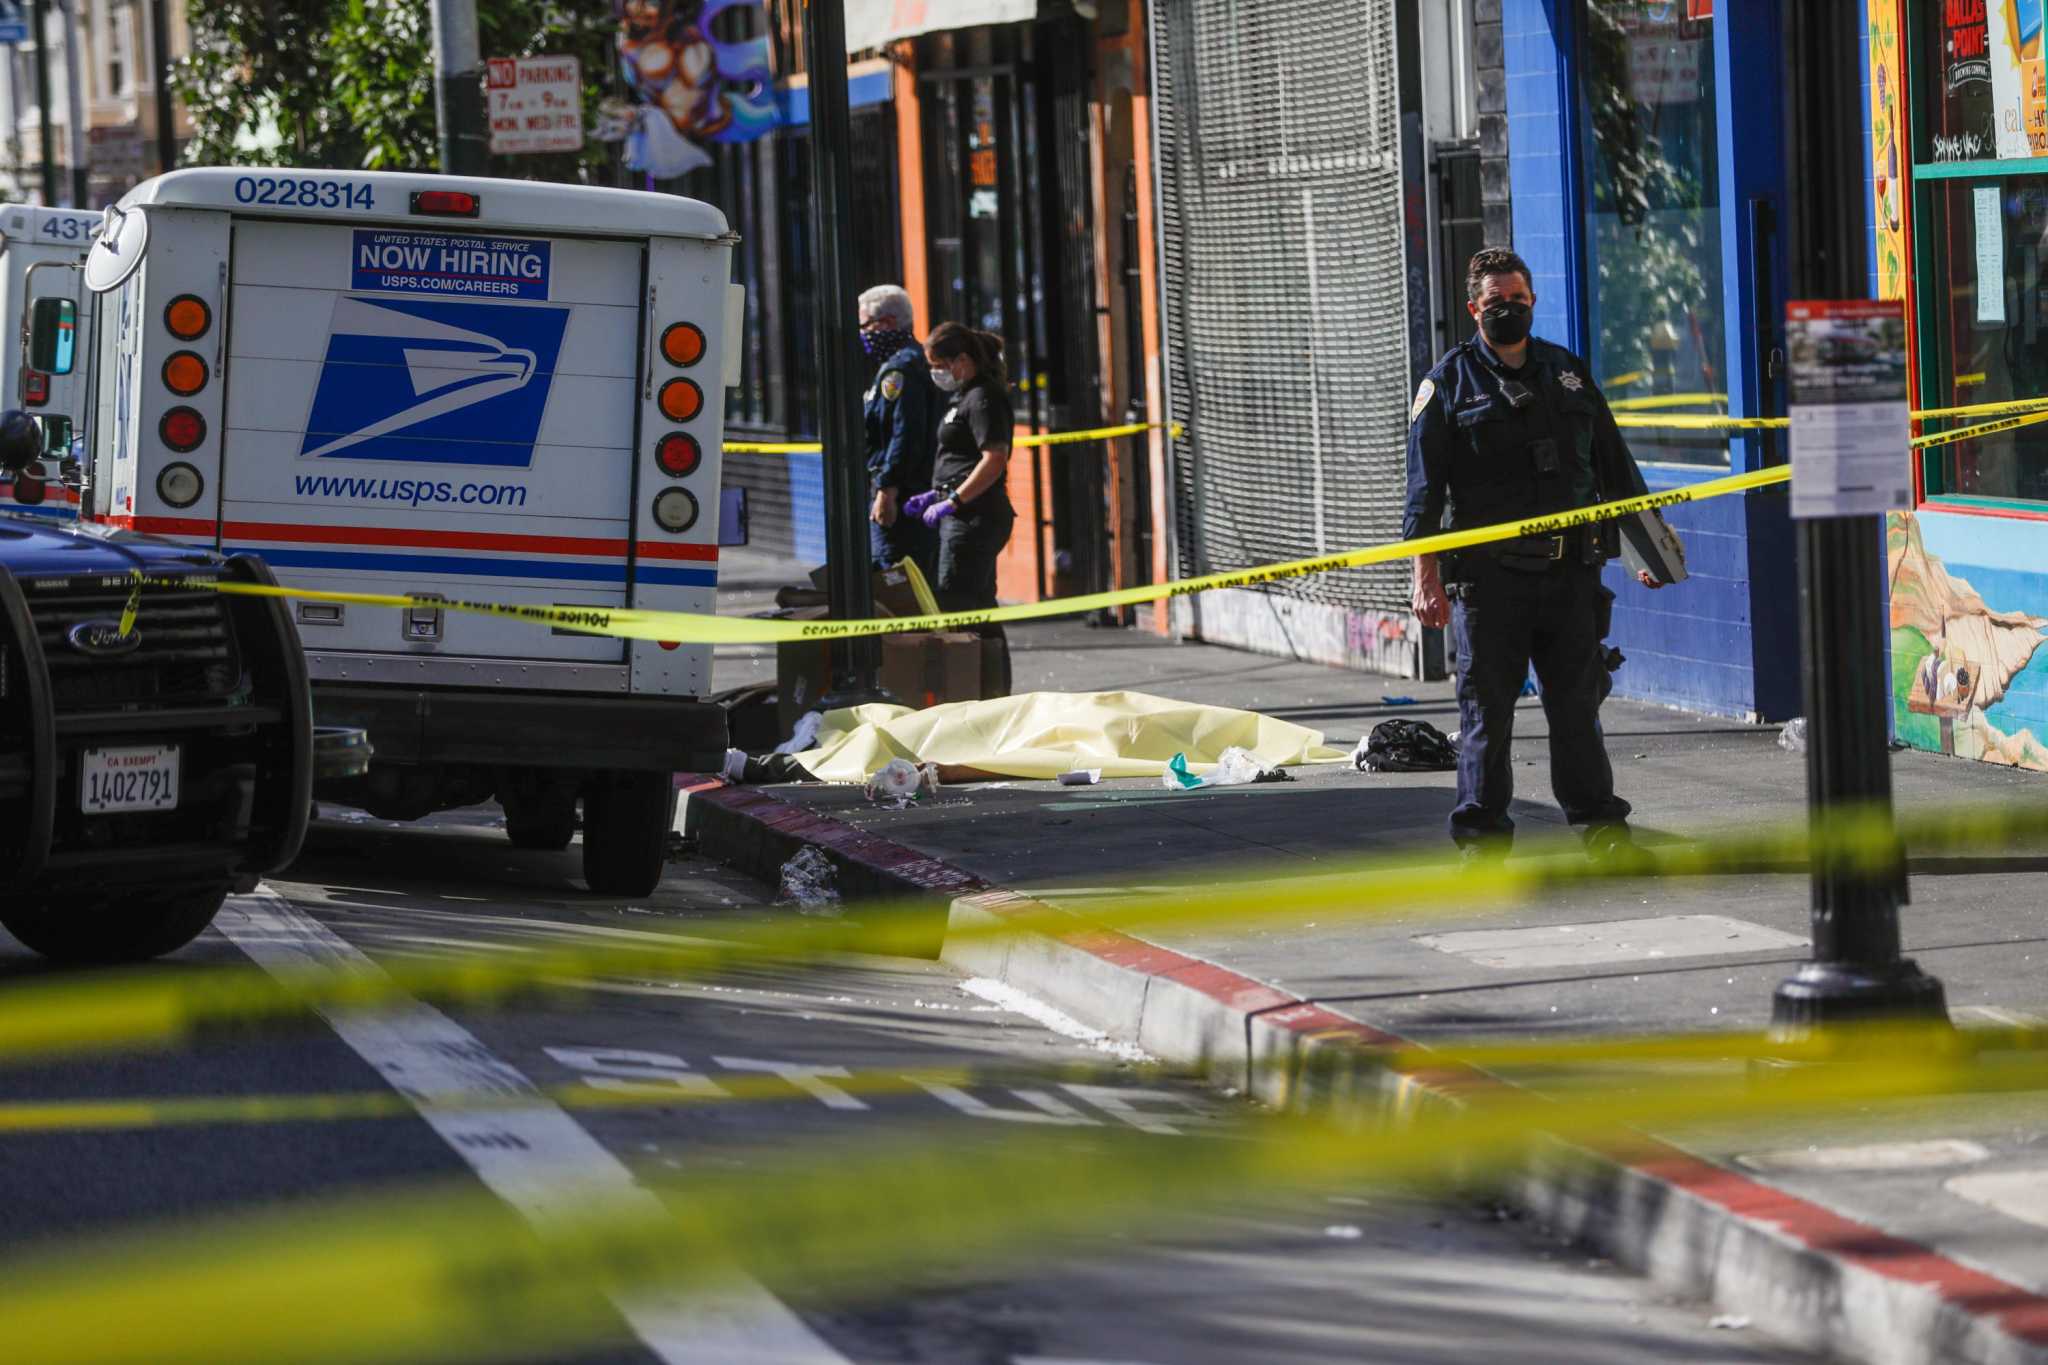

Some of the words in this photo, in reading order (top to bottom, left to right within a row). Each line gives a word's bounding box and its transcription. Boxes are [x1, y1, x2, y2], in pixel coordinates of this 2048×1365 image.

[1946, 0, 1985, 28] BALLAS
[1952, 25, 1985, 59] POINT
[234, 176, 376, 210] 0228314
[42, 216, 103, 241] 431
[374, 234, 410, 245] UNITED
[413, 236, 448, 247] STATES
[450, 238, 487, 249] POSTAL
[491, 241, 530, 252] SERVICE
[360, 244, 432, 271] NOW
[440, 248, 542, 279] HIRING
[381, 275, 519, 295] USPS.COM/CAREERS
[295, 474, 527, 507] www.usps.com
[559, 612, 610, 628] POLICE
[107, 757, 119, 768] CA
[123, 755, 157, 767] EXEMPT
[88, 767, 173, 805] 1402791
